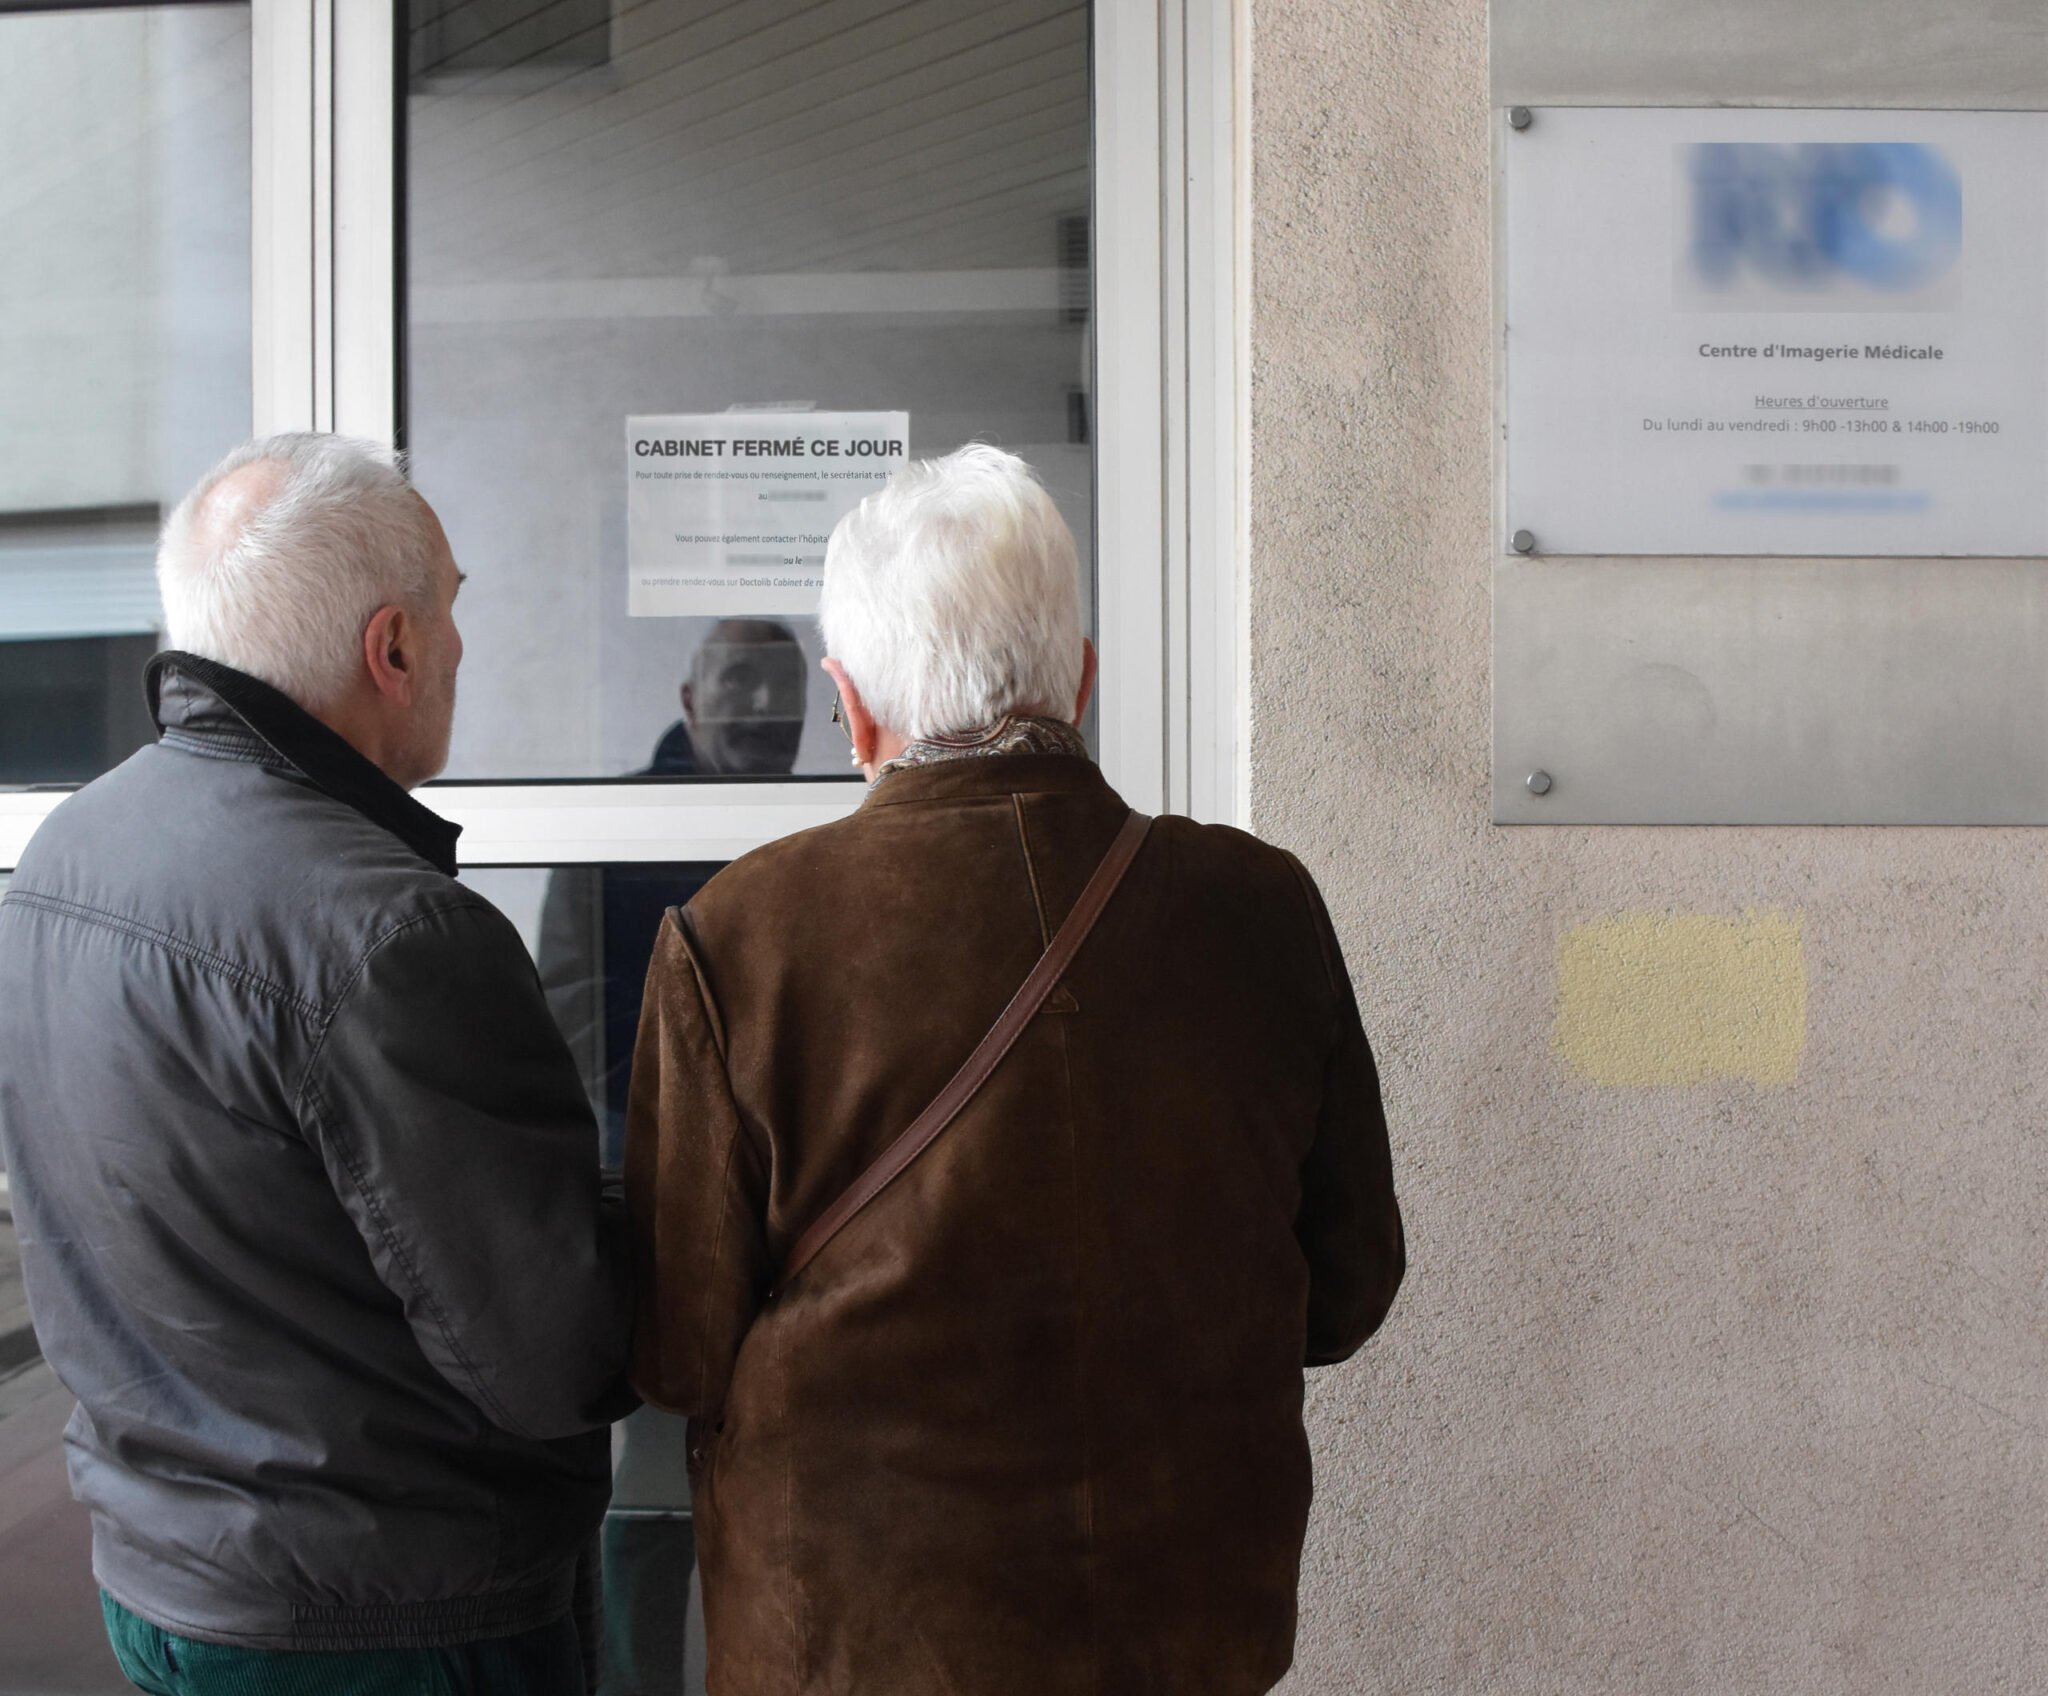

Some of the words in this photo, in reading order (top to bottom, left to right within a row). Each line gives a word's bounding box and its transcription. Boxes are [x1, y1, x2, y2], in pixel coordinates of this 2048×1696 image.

[1698, 344, 1757, 358] Centre
[1763, 344, 1859, 362] d'Imagerie
[1864, 345, 1944, 360] Médicale
[1755, 395, 1803, 409] Heures
[1807, 395, 1888, 410] d'ouverture
[1643, 418, 1663, 431] Du
[1667, 418, 1702, 431] lundi
[1707, 421, 1724, 431] au
[1729, 418, 1790, 432] vendredi
[1802, 419, 1836, 432] 9h00
[1840, 420, 1888, 433] -13h00
[1892, 420, 1901, 433] &
[1907, 420, 1949, 434] 14h00
[1951, 421, 1999, 434] -19h00
[635, 439, 726, 457] CABINET
[733, 436, 805, 457] FERMÉ
[811, 439, 840, 457] CE
[845, 439, 903, 457] JOUR
[635, 471, 652, 480] Pour
[654, 471, 673, 480] toute
[674, 471, 692, 481] prise
[693, 470, 703, 480] de
[704, 470, 749, 480] rendez-vous
[761, 470, 819, 481] renseignement,
[821, 470, 829, 480] le
[830, 470, 872, 480] secrétariat
[874, 472, 886, 480] est
[675, 534, 693, 543] Vous
[694, 535, 720, 544] pouvez
[722, 533, 760, 544] également
[762, 534, 796, 543] contacter
[784, 557, 793, 565] ou
[795, 556, 803, 565] le
[641, 578, 651, 586] ou
[652, 576, 680, 587] prendre
[682, 576, 725, 586] rendez-vous
[727, 578, 738, 586] sur
[739, 577, 771, 587] Doctolib
[773, 577, 802, 587] Cabinet
[803, 577, 815, 587] de
